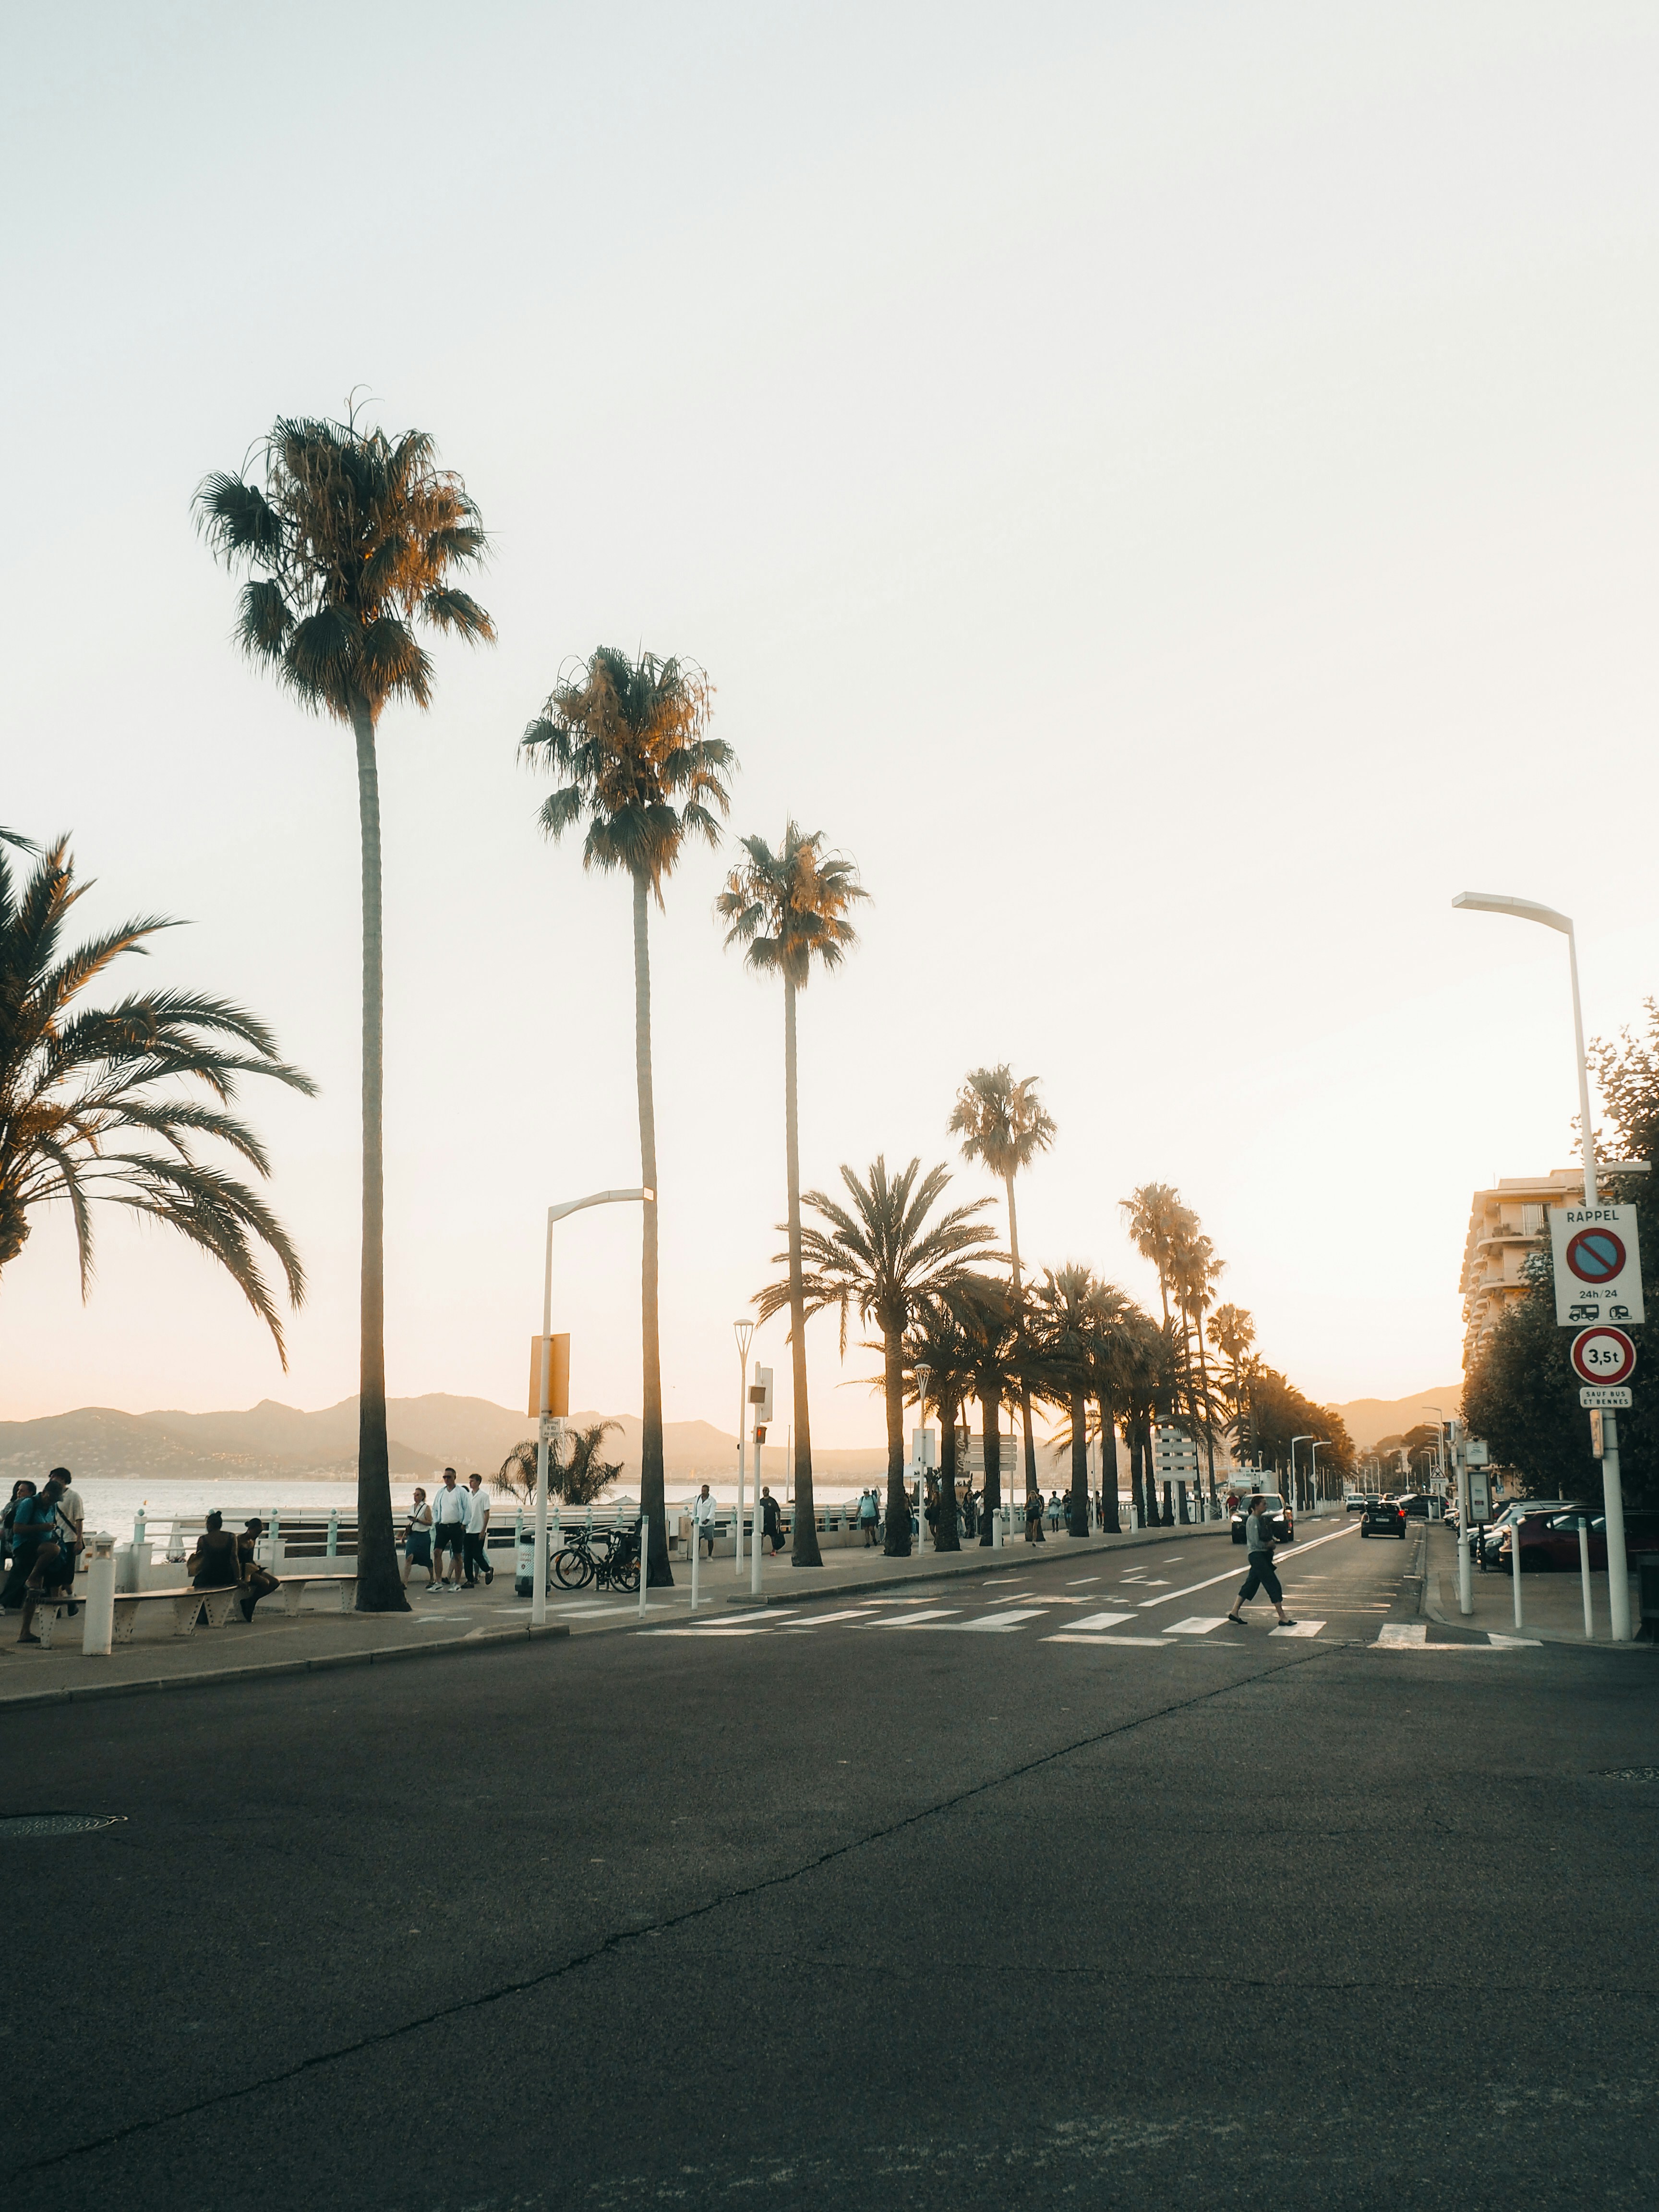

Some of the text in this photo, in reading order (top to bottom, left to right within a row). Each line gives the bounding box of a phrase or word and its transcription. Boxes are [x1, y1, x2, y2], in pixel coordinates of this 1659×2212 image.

[1567, 1210, 1620, 1223] RAPPEL
[1579, 1289, 1618, 1299] 24h/24
[1588, 1348, 1619, 1366] 3,5t
